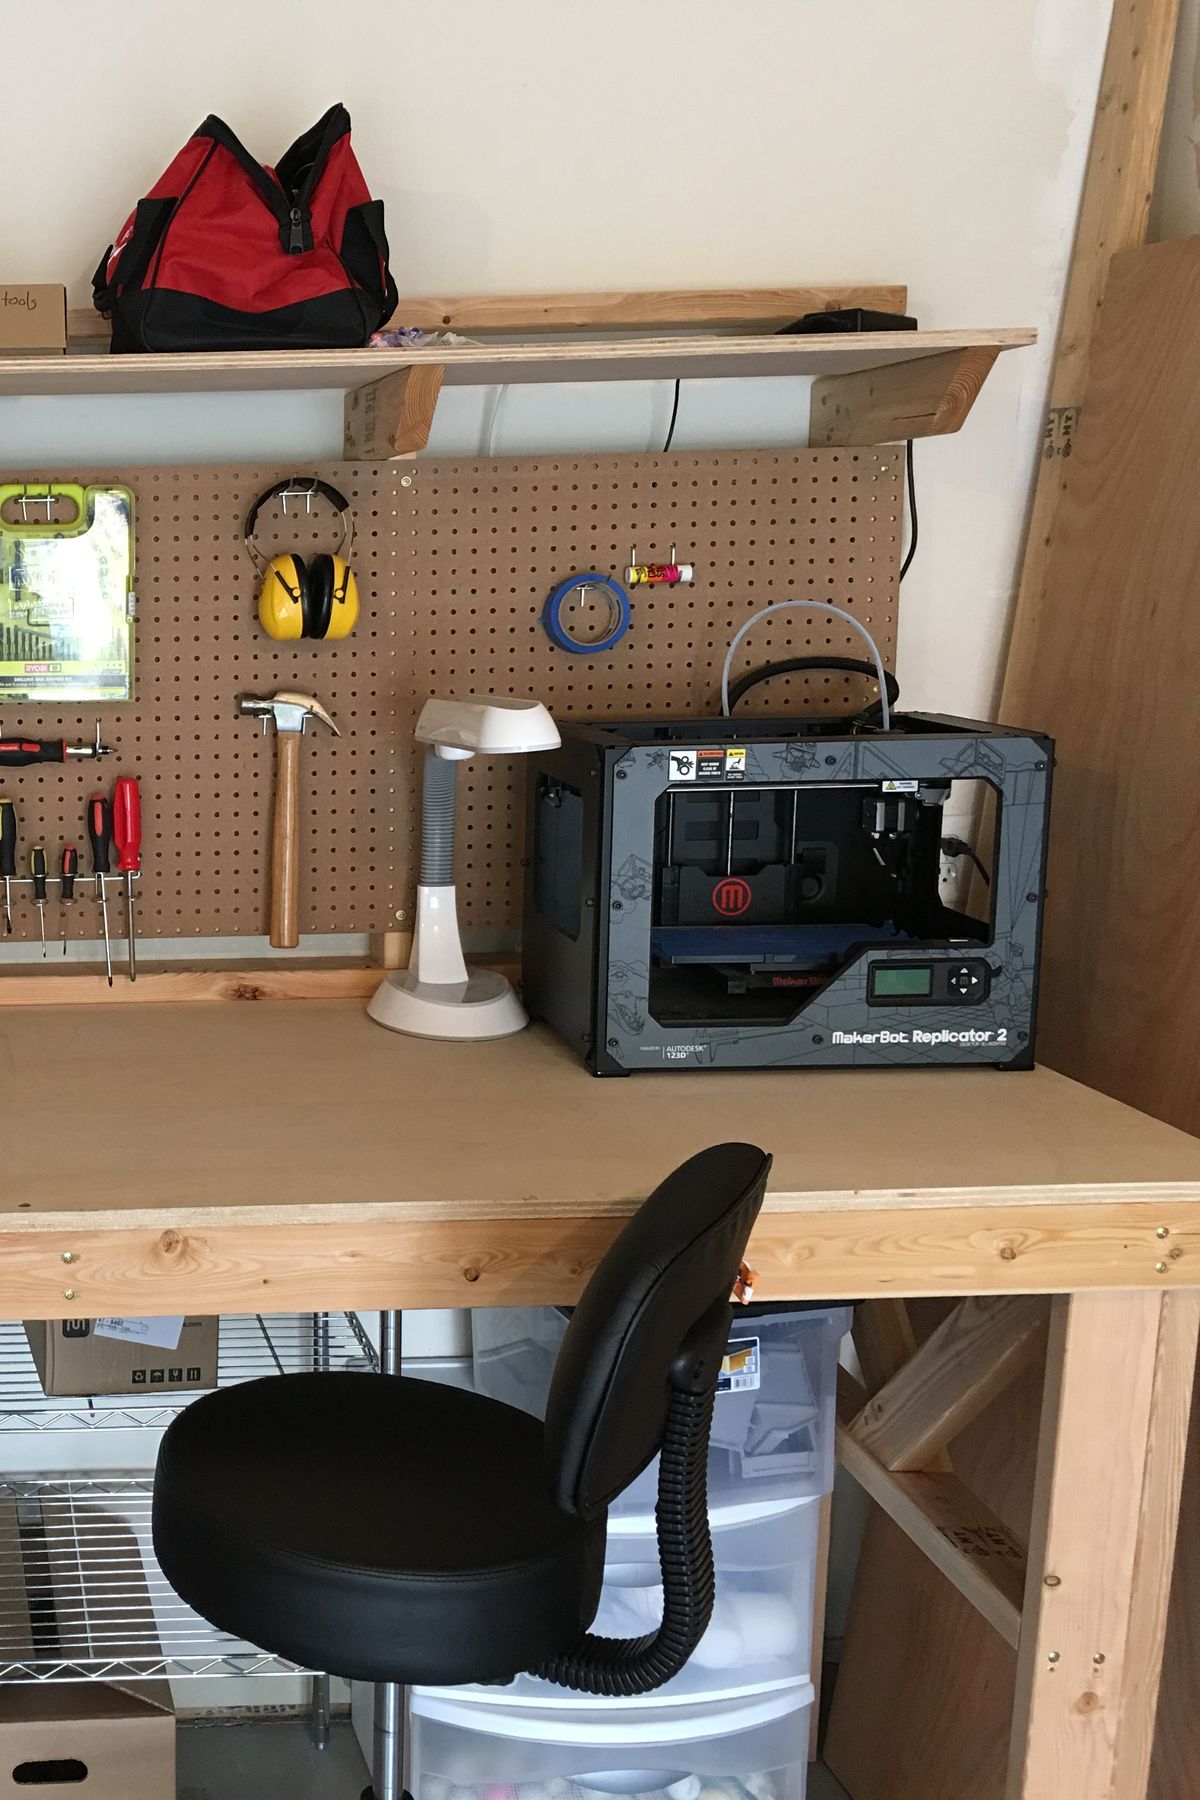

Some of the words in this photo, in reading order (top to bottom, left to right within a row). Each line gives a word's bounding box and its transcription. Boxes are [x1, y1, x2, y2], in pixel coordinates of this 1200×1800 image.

[1, 291, 37, 310] tools
[832, 1030, 909, 1044] MakerBot
[912, 1028, 995, 1046] Replicator
[996, 1028, 1007, 1042] 2
